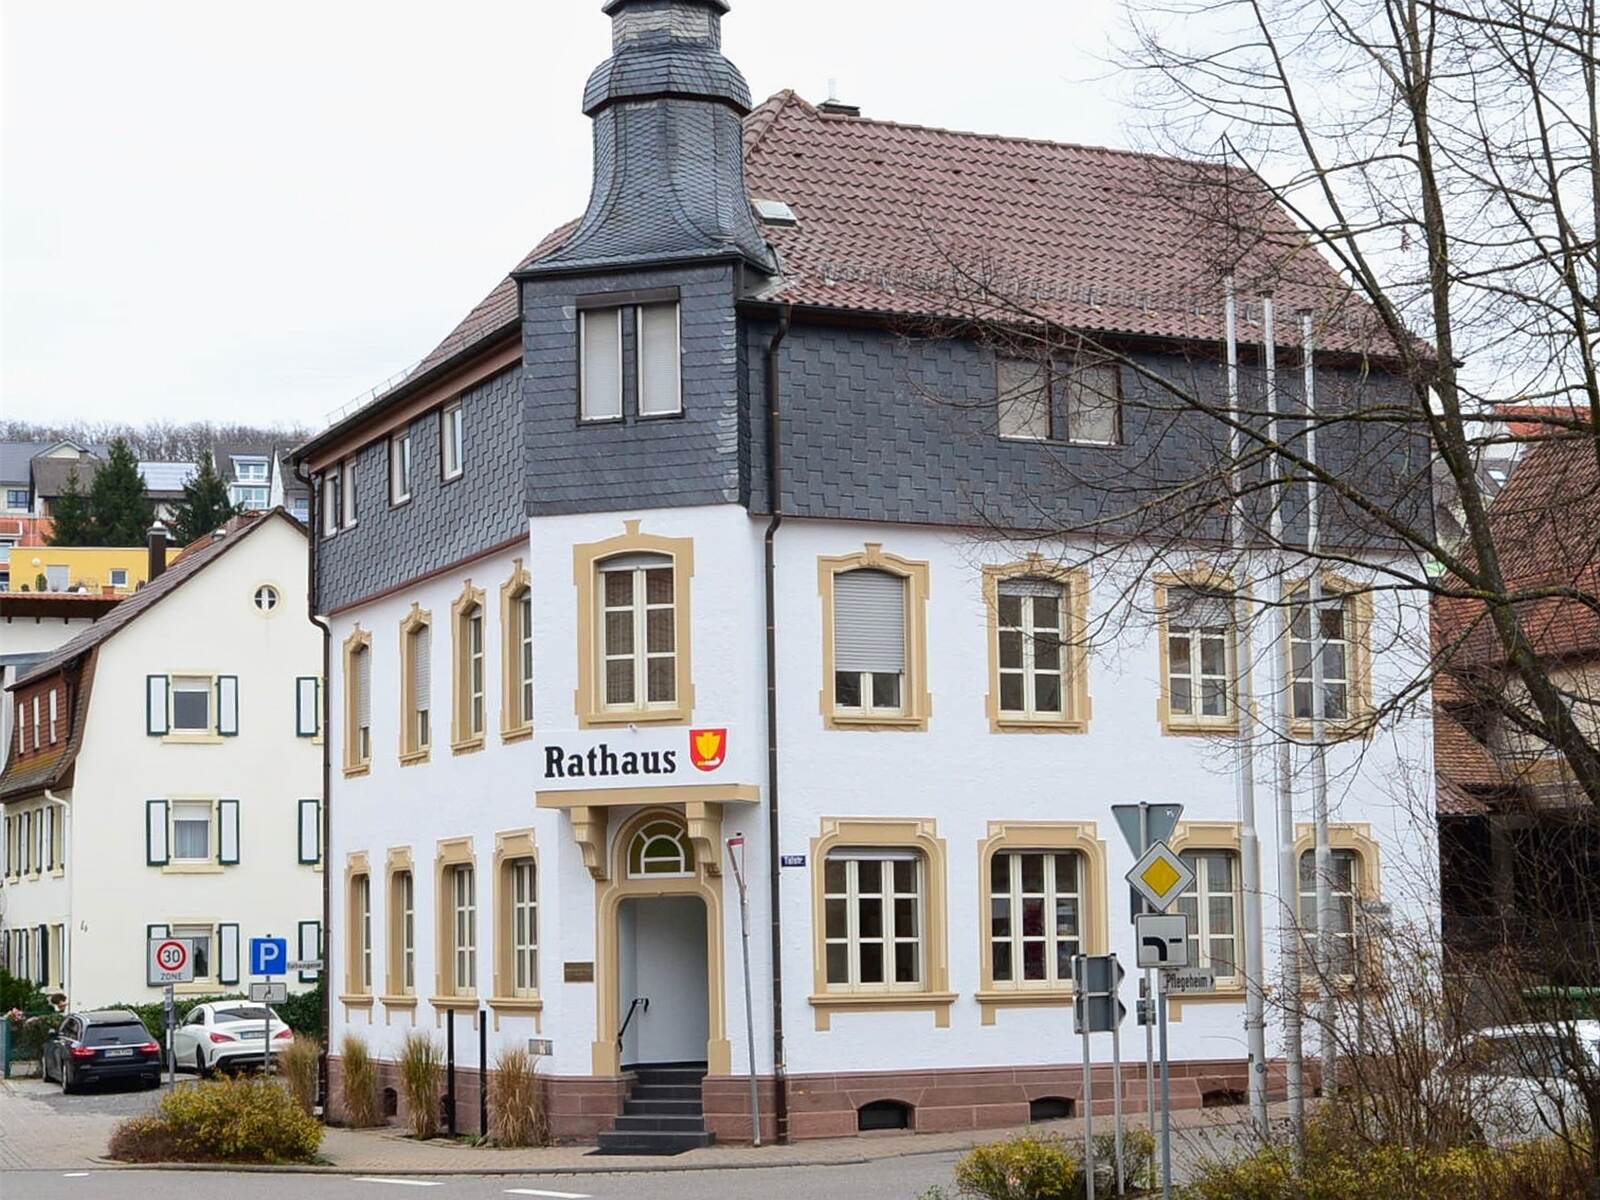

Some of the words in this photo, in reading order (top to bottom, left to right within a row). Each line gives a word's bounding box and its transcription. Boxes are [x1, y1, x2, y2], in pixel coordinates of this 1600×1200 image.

[544, 744, 677, 778] Rathaus
[163, 949, 180, 963] 30
[260, 943, 279, 971] P
[160, 972, 183, 981] ZONE
[1166, 972, 1208, 992] Pflegeheim
